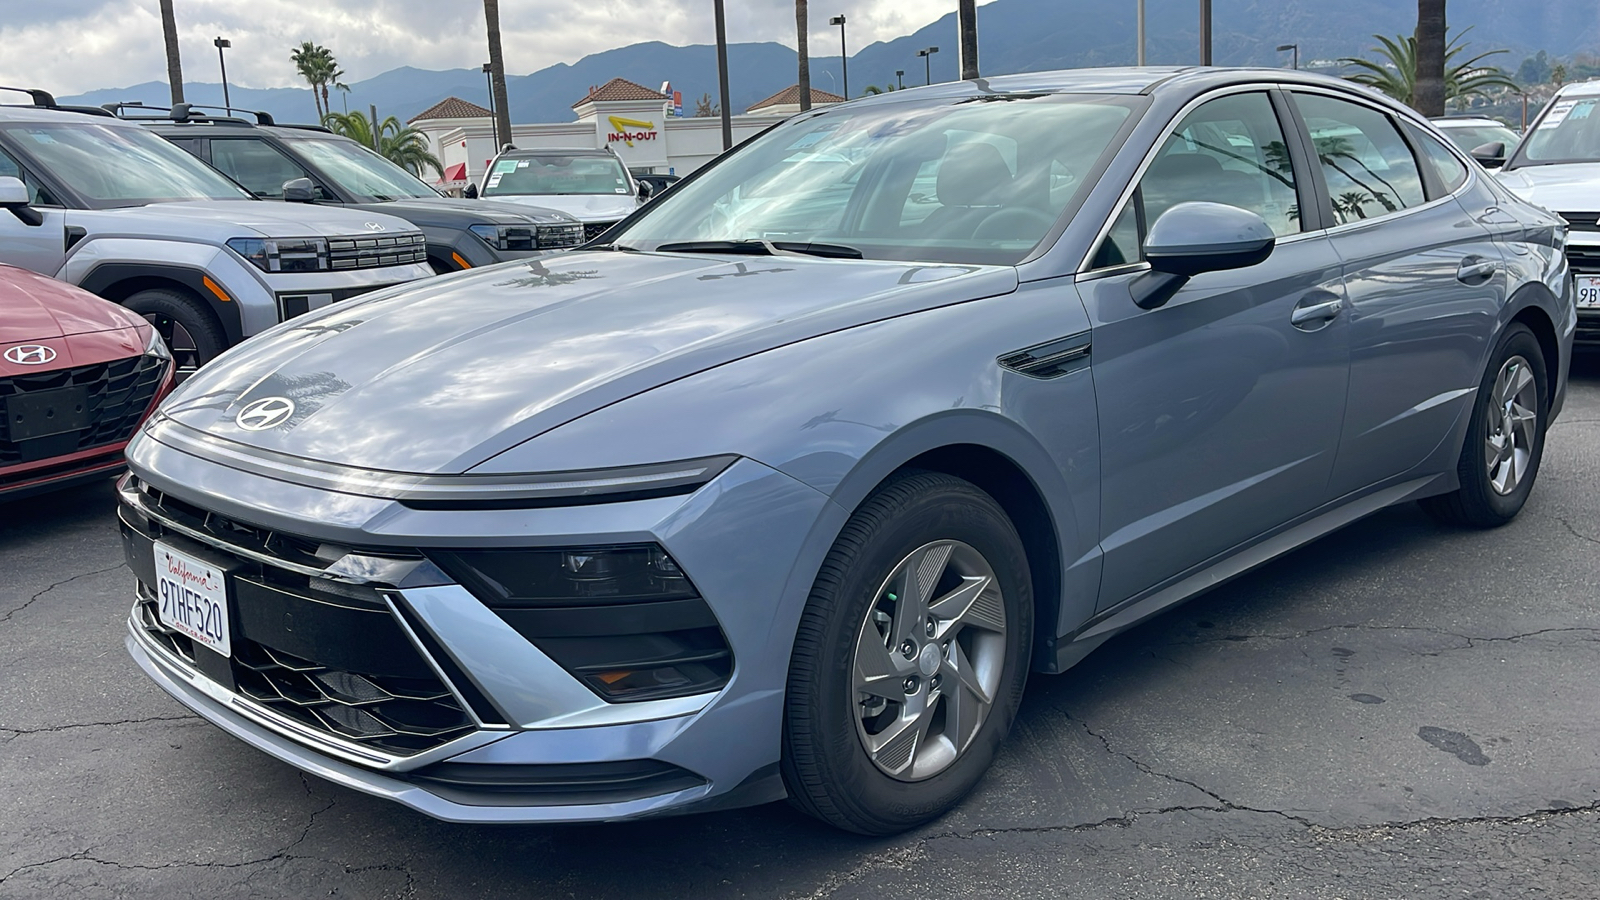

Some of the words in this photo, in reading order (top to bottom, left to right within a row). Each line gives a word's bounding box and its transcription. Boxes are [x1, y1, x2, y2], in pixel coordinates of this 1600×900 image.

[607, 131, 658, 142] IN-N-OUT
[1580, 288, 1600, 303] 9B
[168, 555, 213, 591] California
[160, 577, 223, 642] 9THF520
